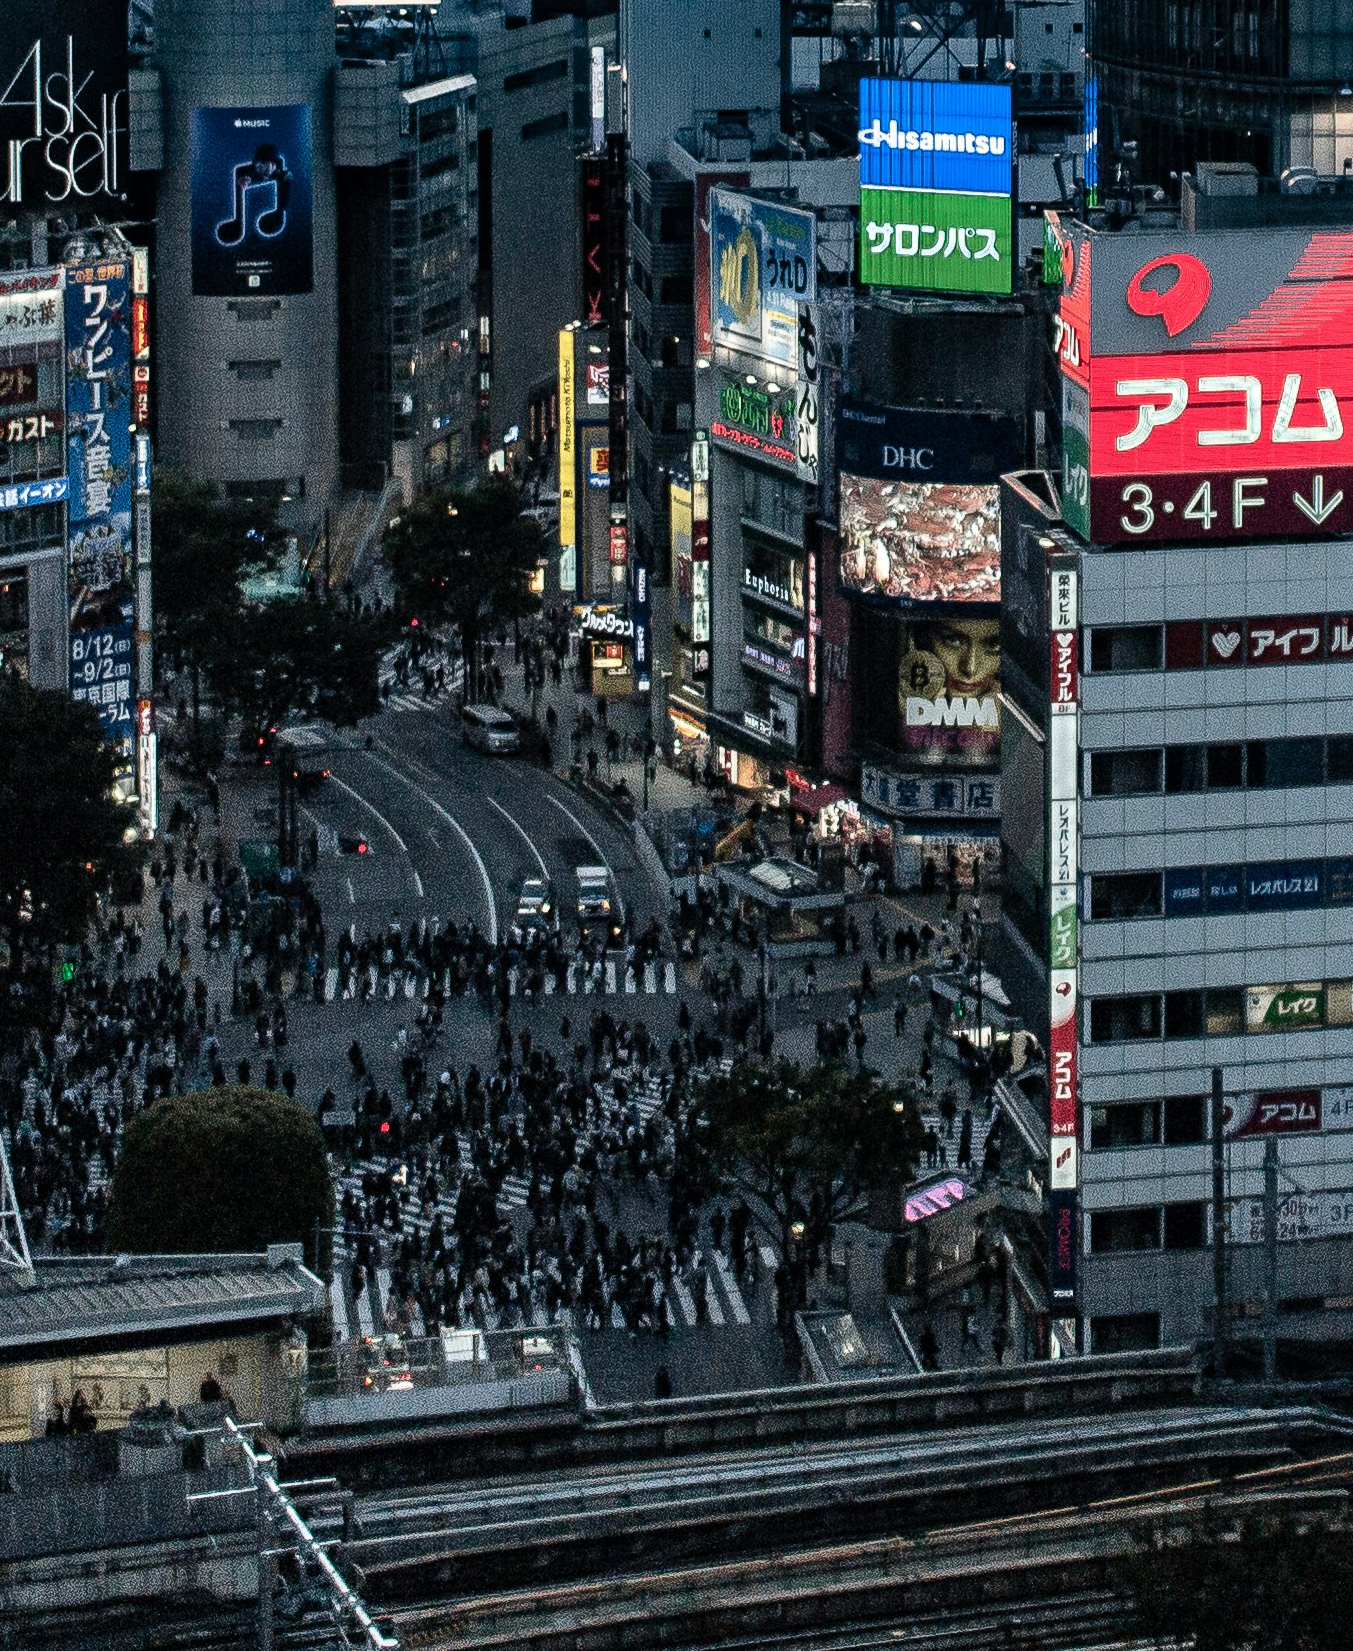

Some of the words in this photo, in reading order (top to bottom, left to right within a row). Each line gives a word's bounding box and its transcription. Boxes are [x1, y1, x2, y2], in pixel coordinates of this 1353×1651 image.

[243, 119, 271, 128] MUSIC
[858, 118, 1007, 156] Hisamitsu
[866, 220, 1001, 263] サロンパス
[1054, 313, 1080, 367] アコム
[1116, 372, 1345, 452] アコム
[7, 414, 56, 444] ガスト
[882, 445, 935, 470] DHC
[745, 568, 789, 602] Euphoria
[581, 606, 634, 639] グルメタウン
[1057, 646, 1072, 703] アイフル
[906, 696, 999, 727] DMM
[1250, 875, 1319, 896] レオパレス21
[1054, 914, 1072, 960] レイク
[1277, 996, 1317, 1016] レイク
[1055, 1051, 1073, 1099] アコム
[1259, 1101, 1317, 1124] アコム
